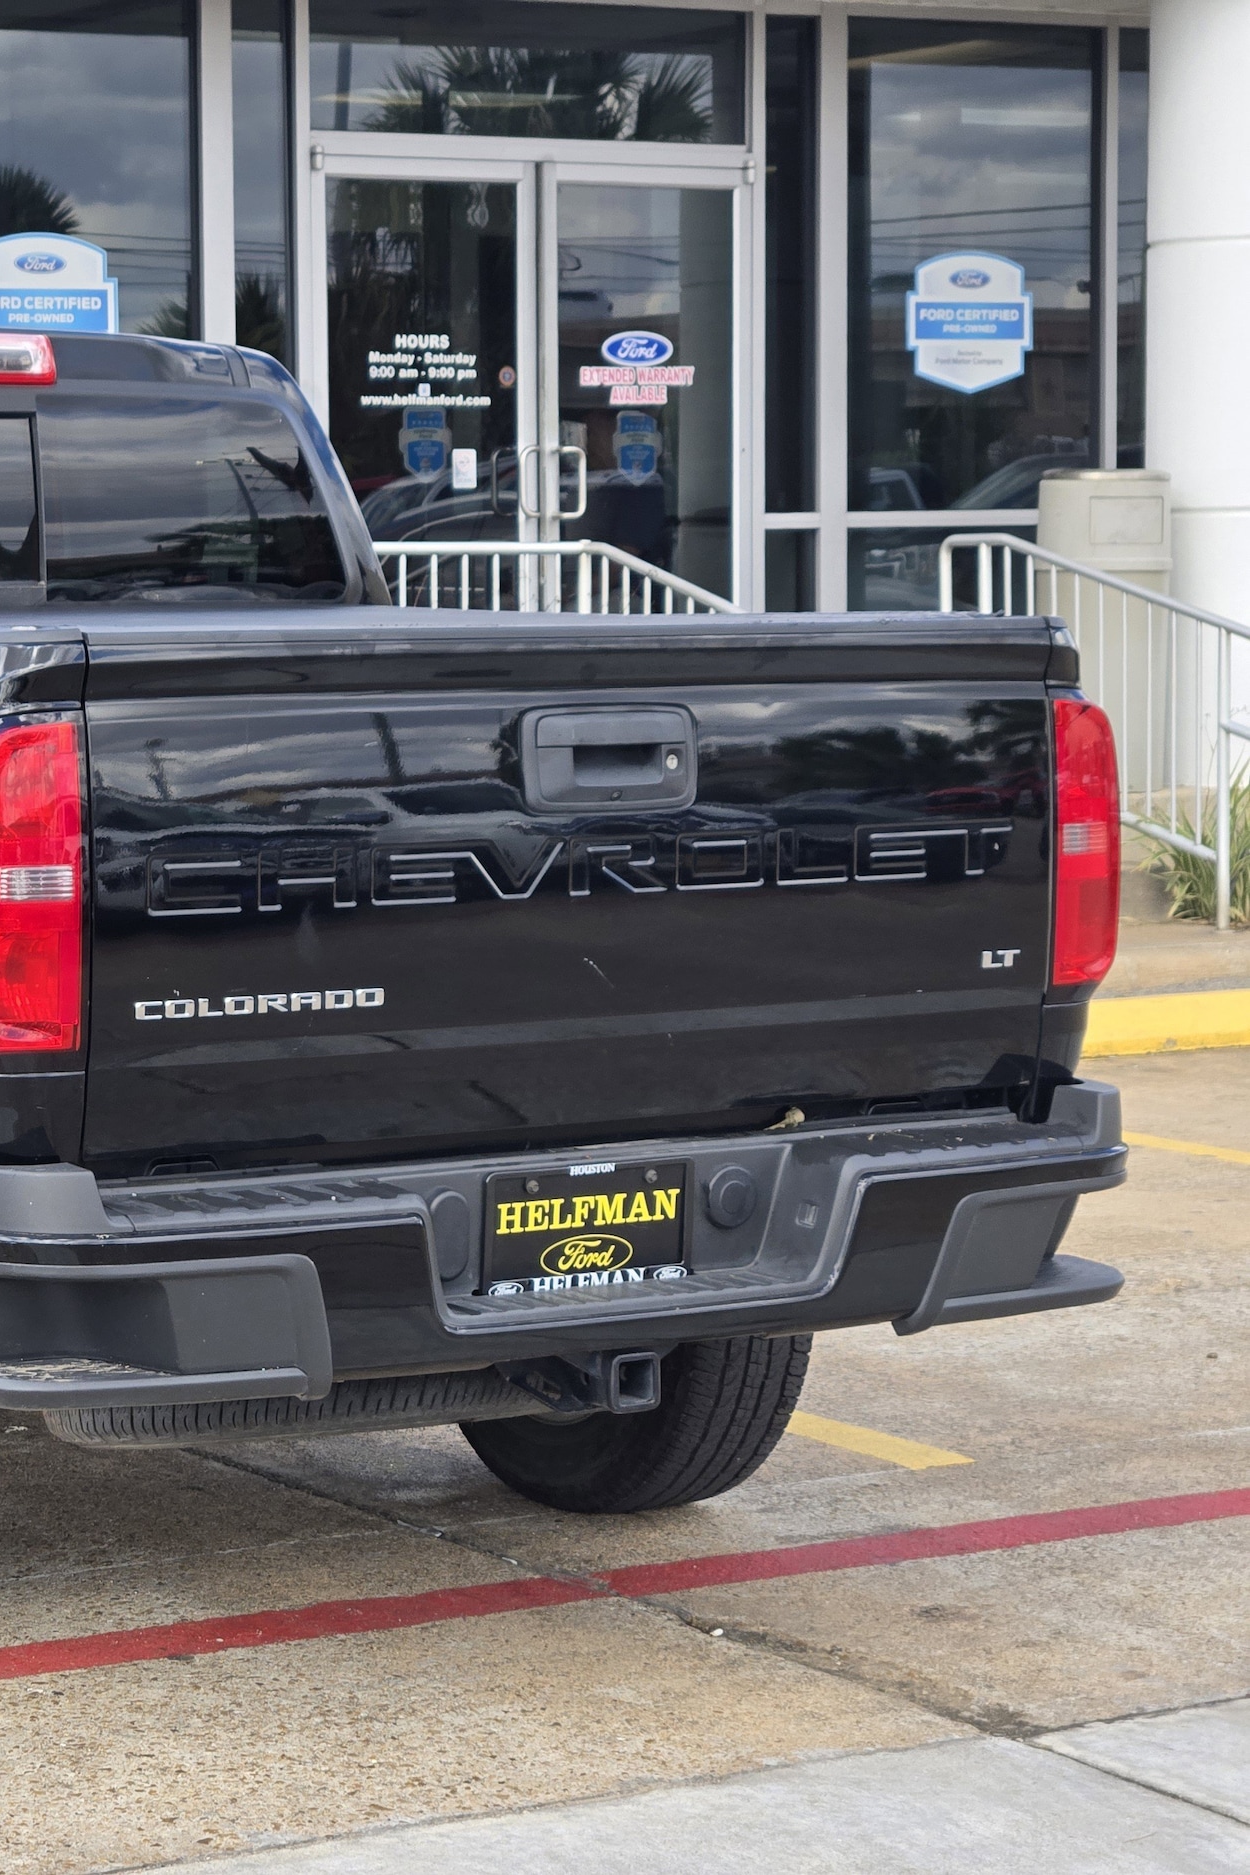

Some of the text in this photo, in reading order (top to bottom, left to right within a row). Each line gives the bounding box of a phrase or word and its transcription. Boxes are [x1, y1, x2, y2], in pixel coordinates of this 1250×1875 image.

[23, 255, 56, 271] Ford
[24, 296, 102, 310] CERTIFIED
[8, 313, 74, 323] PRE-OWNED
[920, 308, 1019, 321] FORD CERTIFIED
[943, 324, 997, 333] PRE-OWNED
[395, 334, 450, 349] HOURS
[617, 337, 658, 359] Ford
[368, 351, 415, 366] Monday
[424, 352, 476, 366] Saturday
[369, 366, 395, 379] 9:00
[399, 368, 418, 379] am
[428, 366, 455, 379] 9:00
[457, 368, 477, 381] pm
[581, 367, 694, 385] EXTENDED WARRANTY
[360, 394, 491, 407] www.helfmanford.com
[611, 387, 667, 403] AVAILABLE
[148, 818, 1013, 916] CHEVROLET
[982, 949, 1021, 968] LT
[135, 988, 385, 1020] COLORADO
[569, 1162, 616, 1176] HOUSTON
[496, 1188, 681, 1234] HELFMAN
[558, 1239, 616, 1271] Ford
